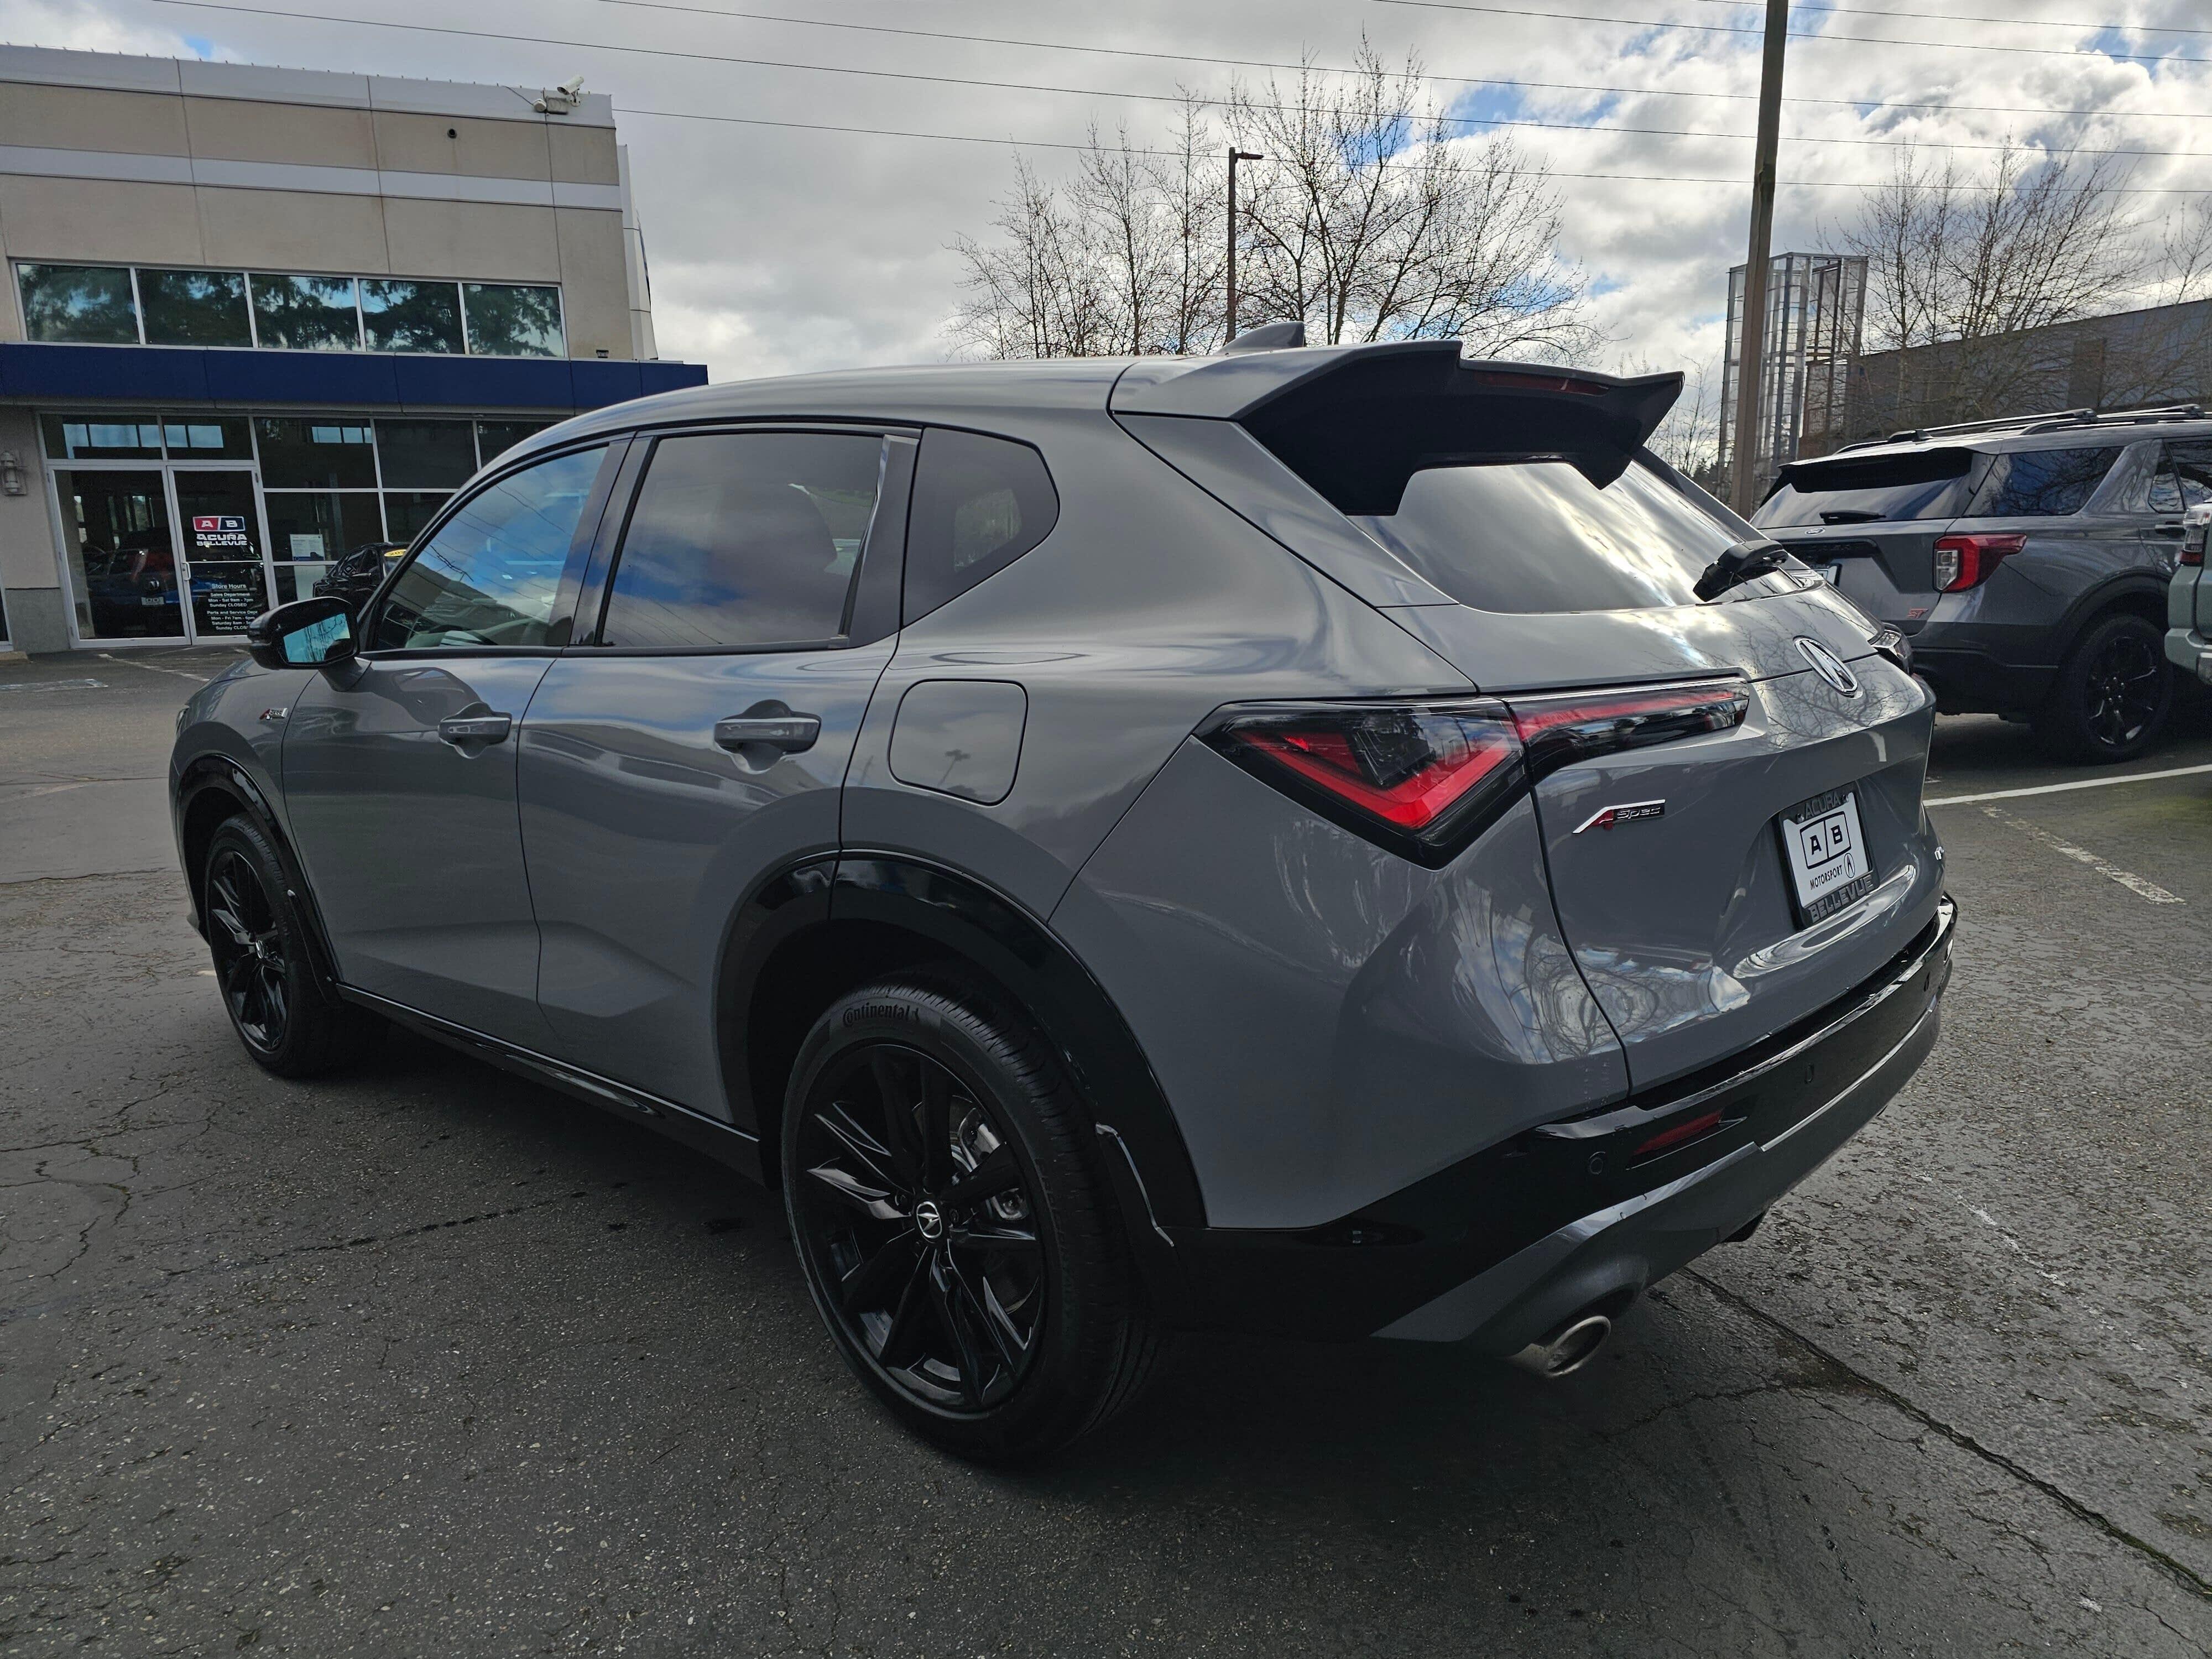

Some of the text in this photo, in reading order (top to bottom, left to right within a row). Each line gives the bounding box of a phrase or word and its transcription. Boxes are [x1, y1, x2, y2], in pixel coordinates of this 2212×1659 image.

[1804, 791, 1841, 820] ACURA
[1810, 825, 1843, 855] A B
[1810, 864, 1843, 890] MOTORSPORT
[1808, 874, 1874, 923] BELLEVUE
[843, 1002, 911, 1027] Continental
